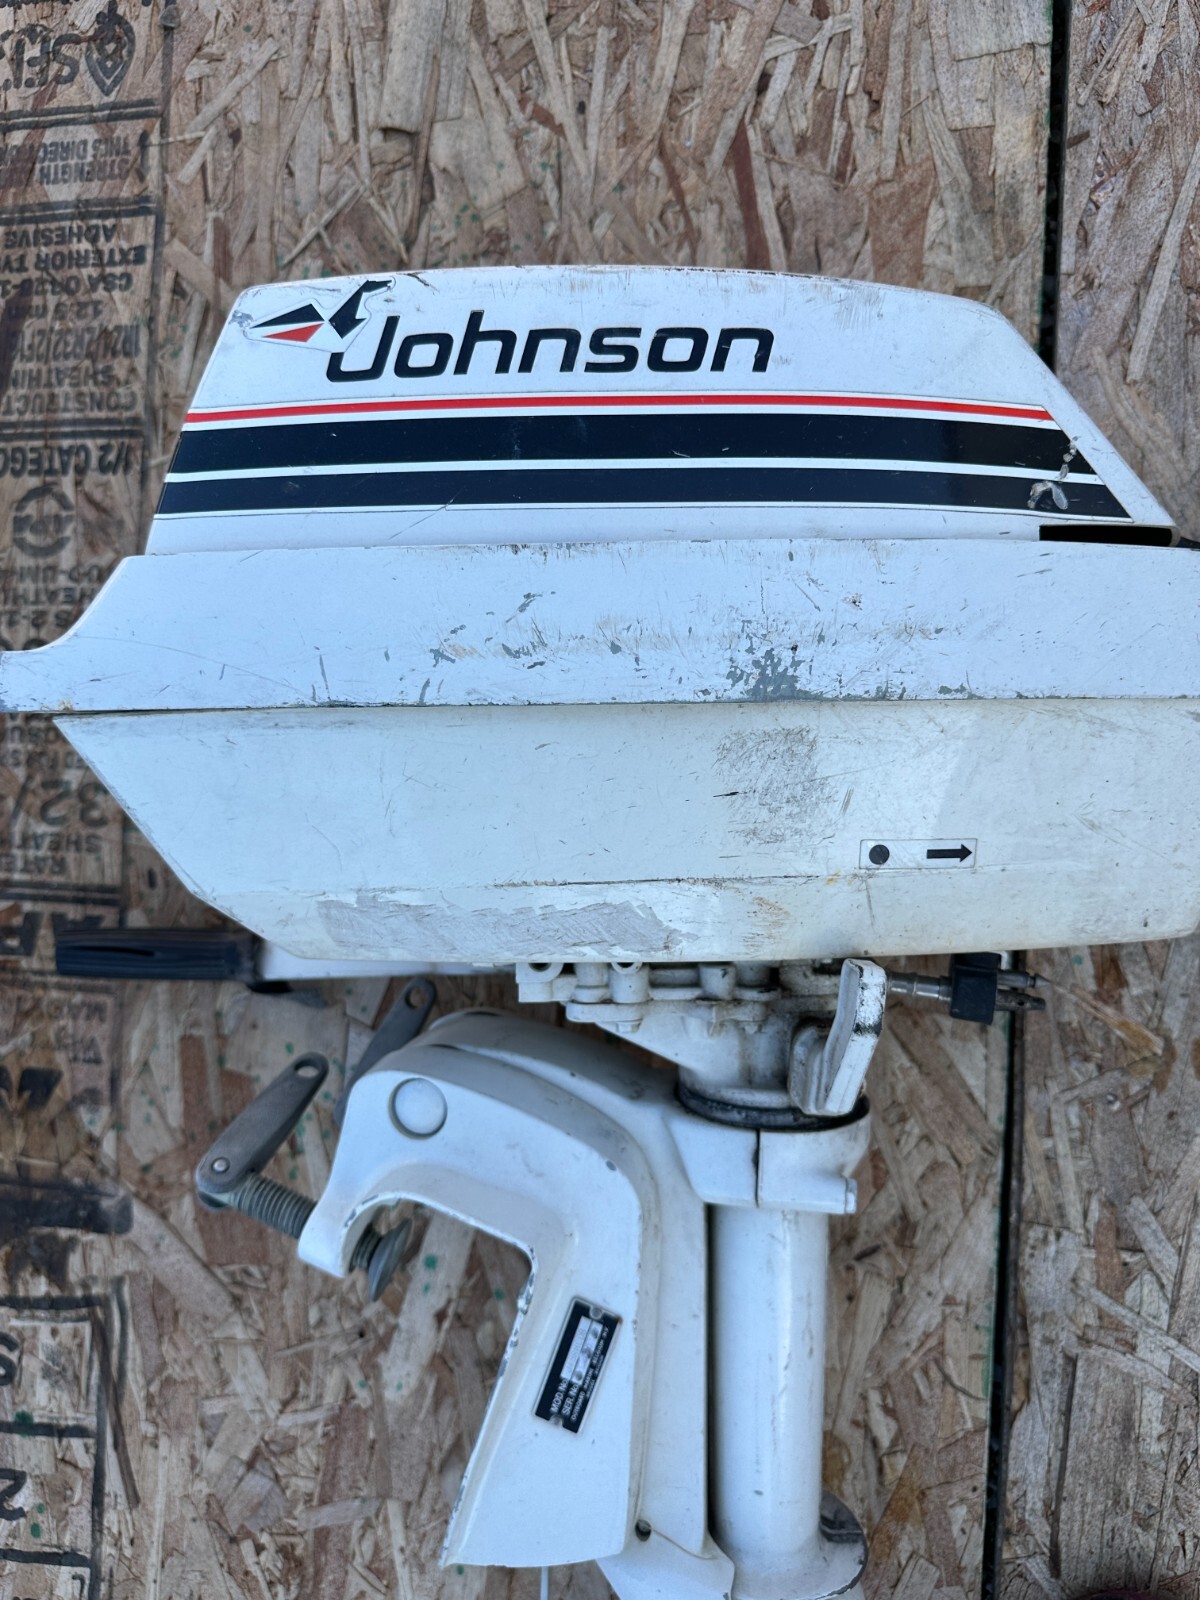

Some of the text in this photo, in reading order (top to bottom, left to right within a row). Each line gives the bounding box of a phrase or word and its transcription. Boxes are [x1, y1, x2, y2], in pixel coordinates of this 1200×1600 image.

[38, 158, 130, 187] STRENGTH
[3, 222, 117, 250] ADHESIVE
[34, 244, 147, 273] EXTERIOR
[87, 272, 133, 294] CSA
[326, 309, 775, 383] Johnson
